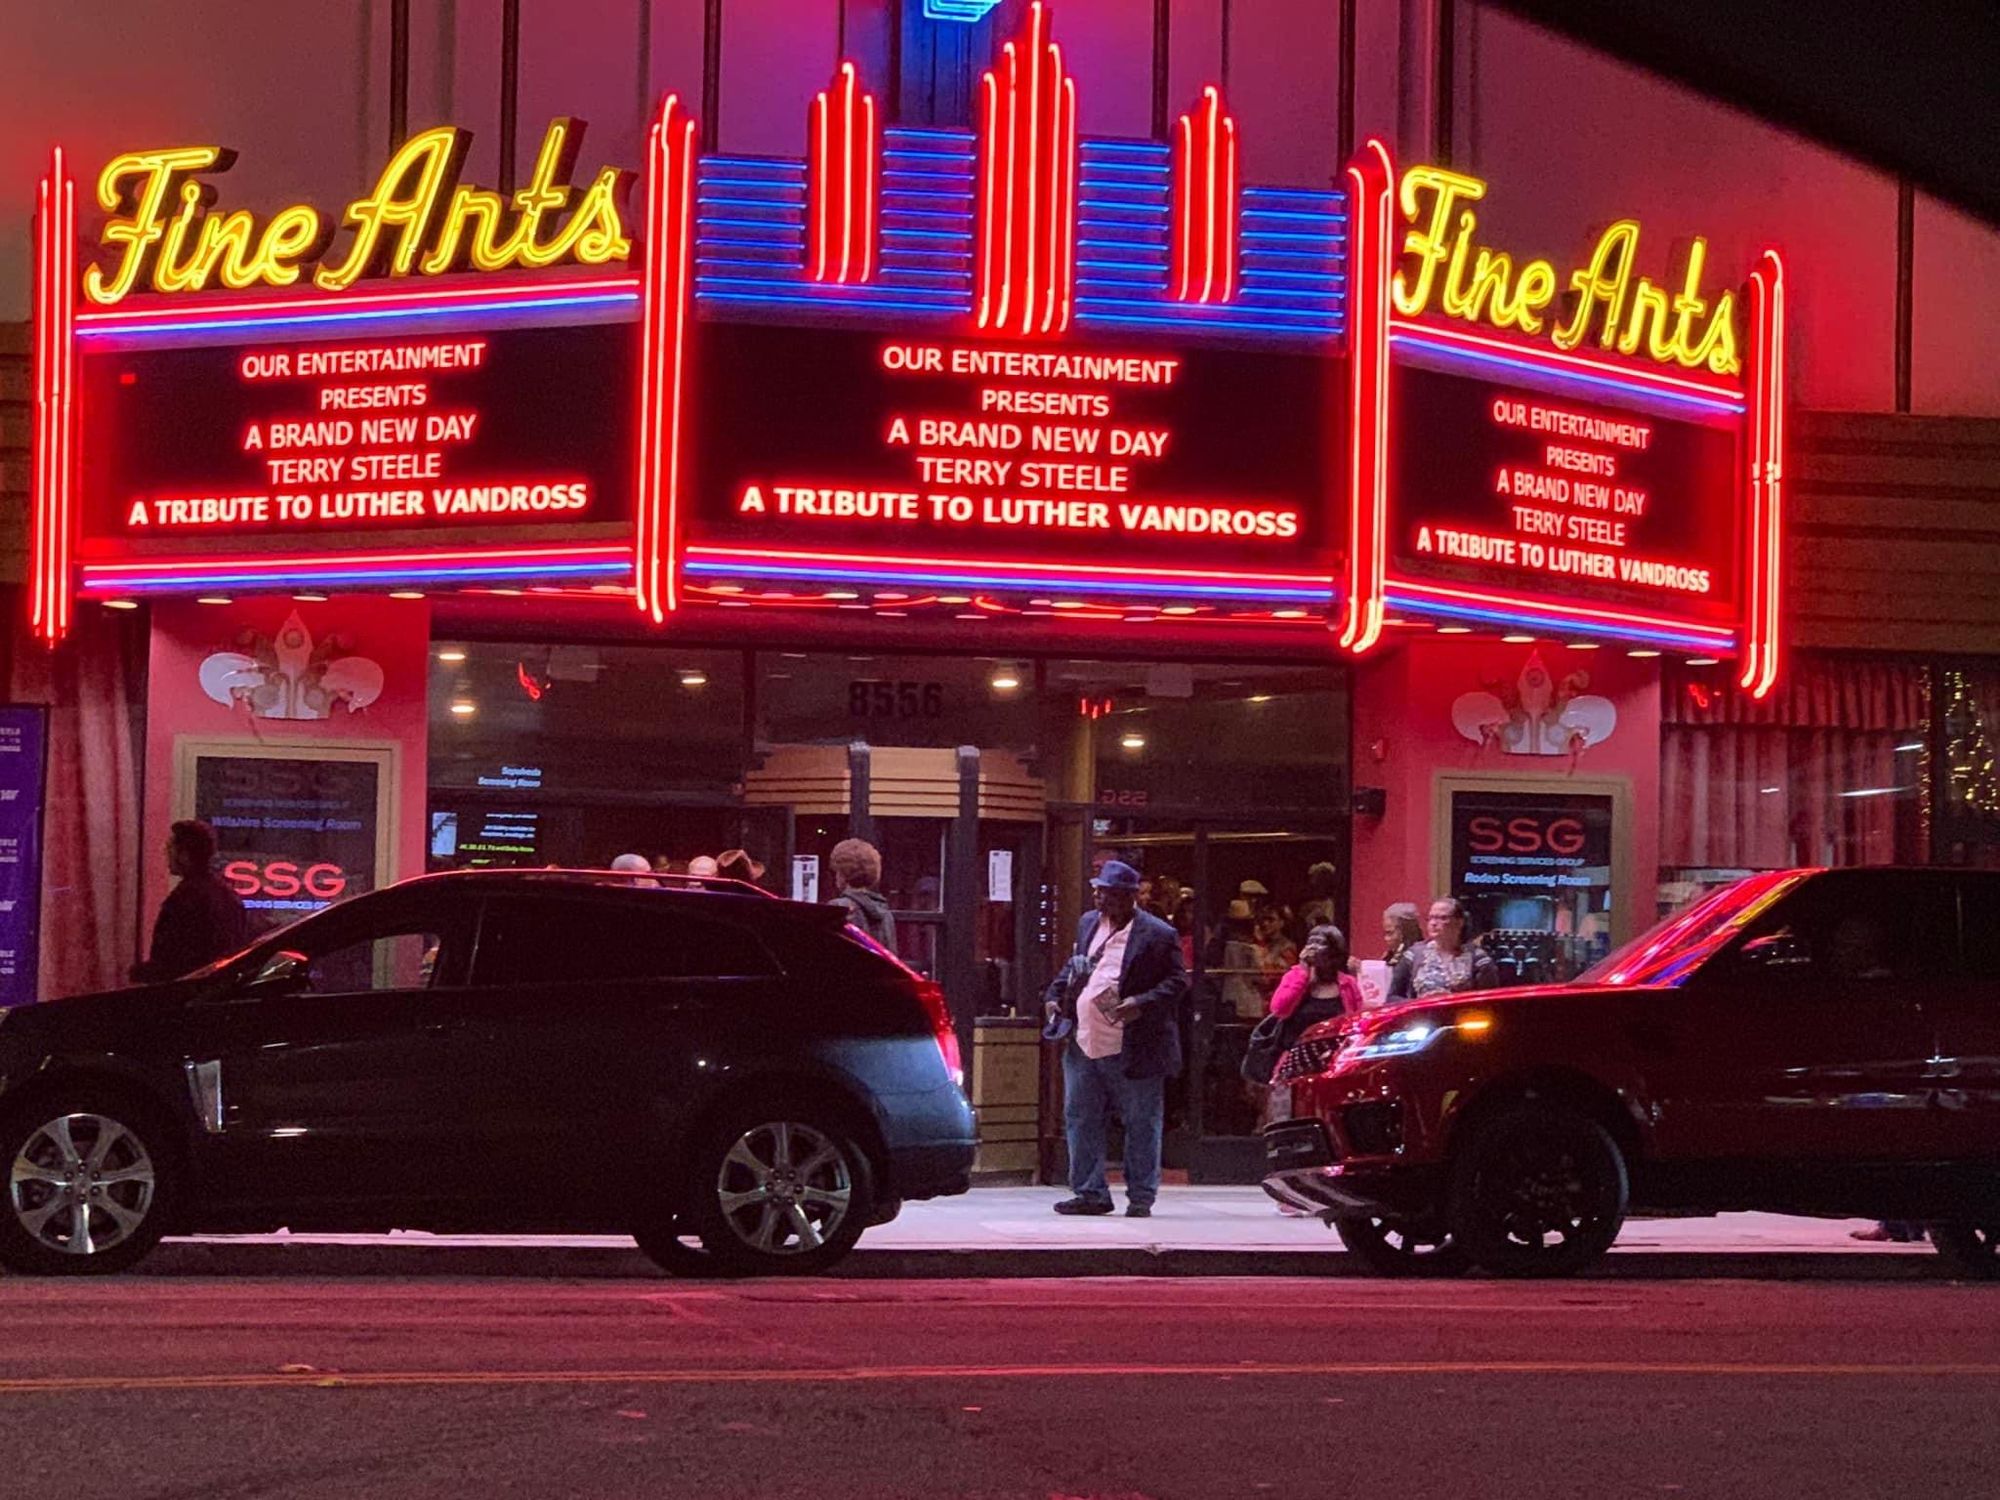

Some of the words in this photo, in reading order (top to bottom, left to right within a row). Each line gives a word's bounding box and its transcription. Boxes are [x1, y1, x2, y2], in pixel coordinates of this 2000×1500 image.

[84, 146, 322, 304] Fine
[314, 120, 632, 291] Arts
[1393, 165, 1556, 334] Fine
[1552, 219, 1742, 375] Arts
[242, 354, 291, 378] OUR
[297, 343, 486, 376] ENTERTAINMENT
[883, 346, 943, 372] OUR
[952, 349, 1178, 384] ENTERTAINMENT
[320, 383, 427, 410] PRESENTS
[982, 389, 1110, 417] PRESENTS
[244, 425, 263, 450] A
[270, 421, 354, 449] BRAND
[361, 417, 418, 444] NEW
[426, 414, 476, 442] DAY
[887, 418, 910, 444] A
[919, 419, 1022, 449] BRAND
[1032, 425, 1100, 454] NEW
[1110, 429, 1168, 457] DAY
[1493, 400, 1527, 426] OUR
[1530, 407, 1650, 449] ENTERTAINMENT
[267, 457, 345, 485] TERRY
[350, 452, 441, 481] STEELE
[916, 456, 1012, 486] TERRY
[1020, 462, 1128, 492] STEELE
[1546, 446, 1615, 477] PRESENTS
[128, 501, 149, 526] A
[154, 496, 269, 525] TRIBUTE
[275, 494, 313, 520] TO
[319, 490, 426, 519] LUTHER
[432, 483, 587, 514] VANDROSS
[1496, 468, 1510, 493] A
[1514, 471, 1570, 503] BRAND
[1573, 482, 1610, 509] NEW
[1614, 489, 1645, 515] DAY
[740, 486, 765, 512] A
[773, 487, 919, 519] TRIBUTE
[927, 494, 974, 522] TO
[983, 497, 1110, 529] LUTHER
[1118, 503, 1297, 537] VANDROSS
[1512, 506, 1564, 536] TERRY
[1567, 515, 1625, 547] STEELE
[1416, 526, 1432, 552] A
[1435, 529, 1516, 564] TRIBUTE
[1519, 542, 1545, 568] TO
[1548, 546, 1616, 579] LUTHER
[1619, 558, 1710, 593] VANDROSS
[1468, 816, 1586, 854] SSG
[223, 860, 347, 898] SSG
[1464, 872, 1500, 884] Rodeo
